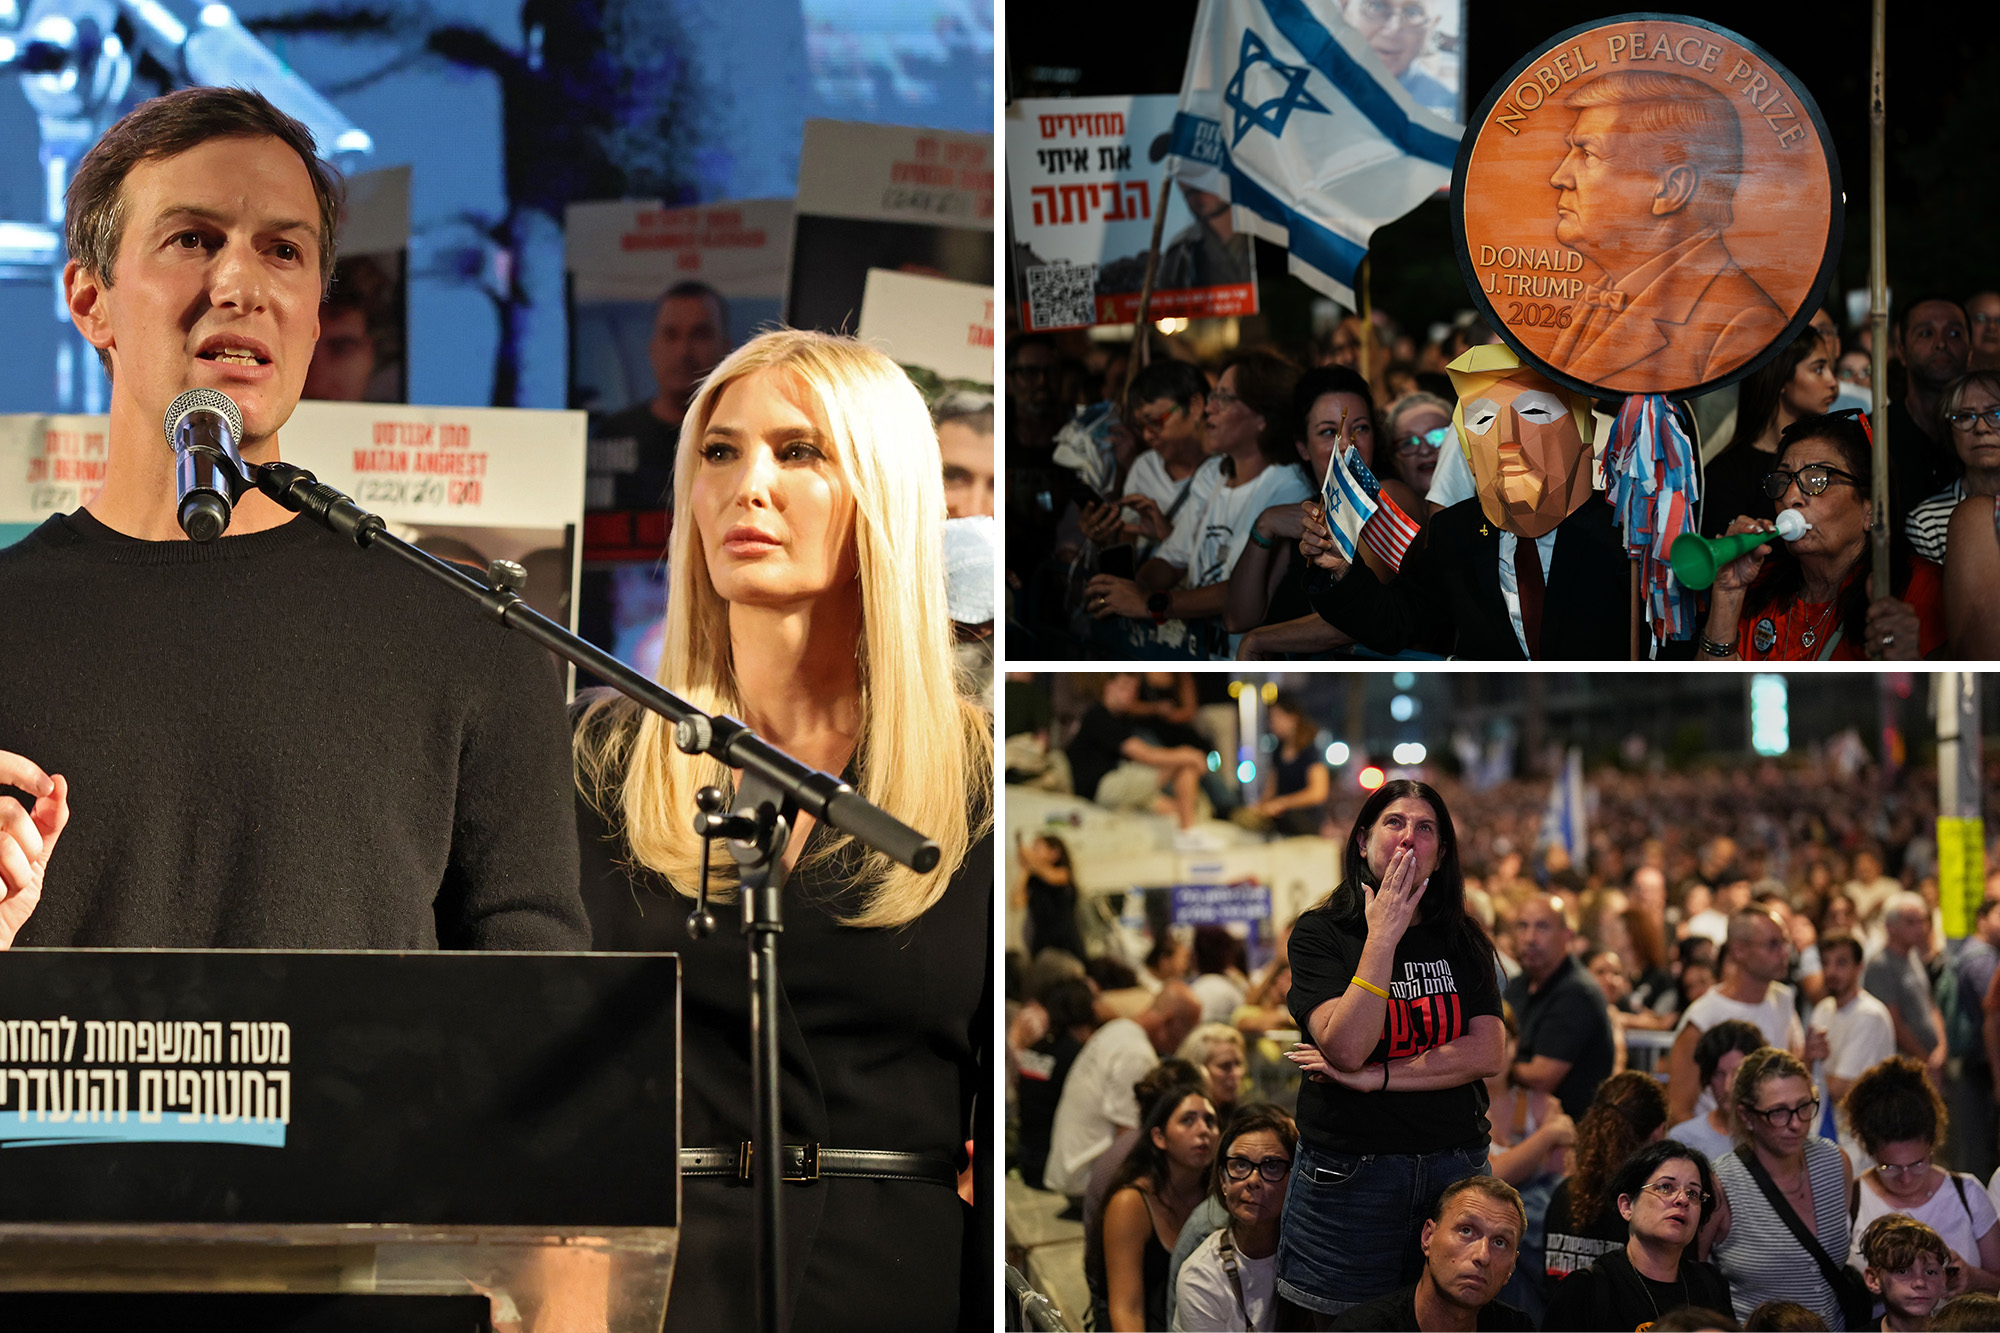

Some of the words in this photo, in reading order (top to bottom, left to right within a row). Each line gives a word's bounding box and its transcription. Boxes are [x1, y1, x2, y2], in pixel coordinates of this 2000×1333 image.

[1495, 45, 1597, 136] NOBEL
[1607, 32, 1722, 73] PEACE
[1725, 58, 1806, 150] PRIZE
[1038, 112, 1125, 138] מחזירים
[1037, 147, 1088, 174] איתי
[1099, 146, 1131, 172] את
[1031, 180, 1151, 226] הביתה
[1479, 244, 1584, 273] DONALD
[1507, 302, 1572, 328] 2026
[353, 449, 409, 473] MATAN
[413, 451, 488, 477] ANGREST
[1404, 959, 1452, 980] מחזירים
[1424, 976, 1457, 994] אותם
[84, 1021, 222, 1063] המשפחות
[231, 1021, 291, 1064] מטה
[139, 1070, 291, 1125] החטופים
